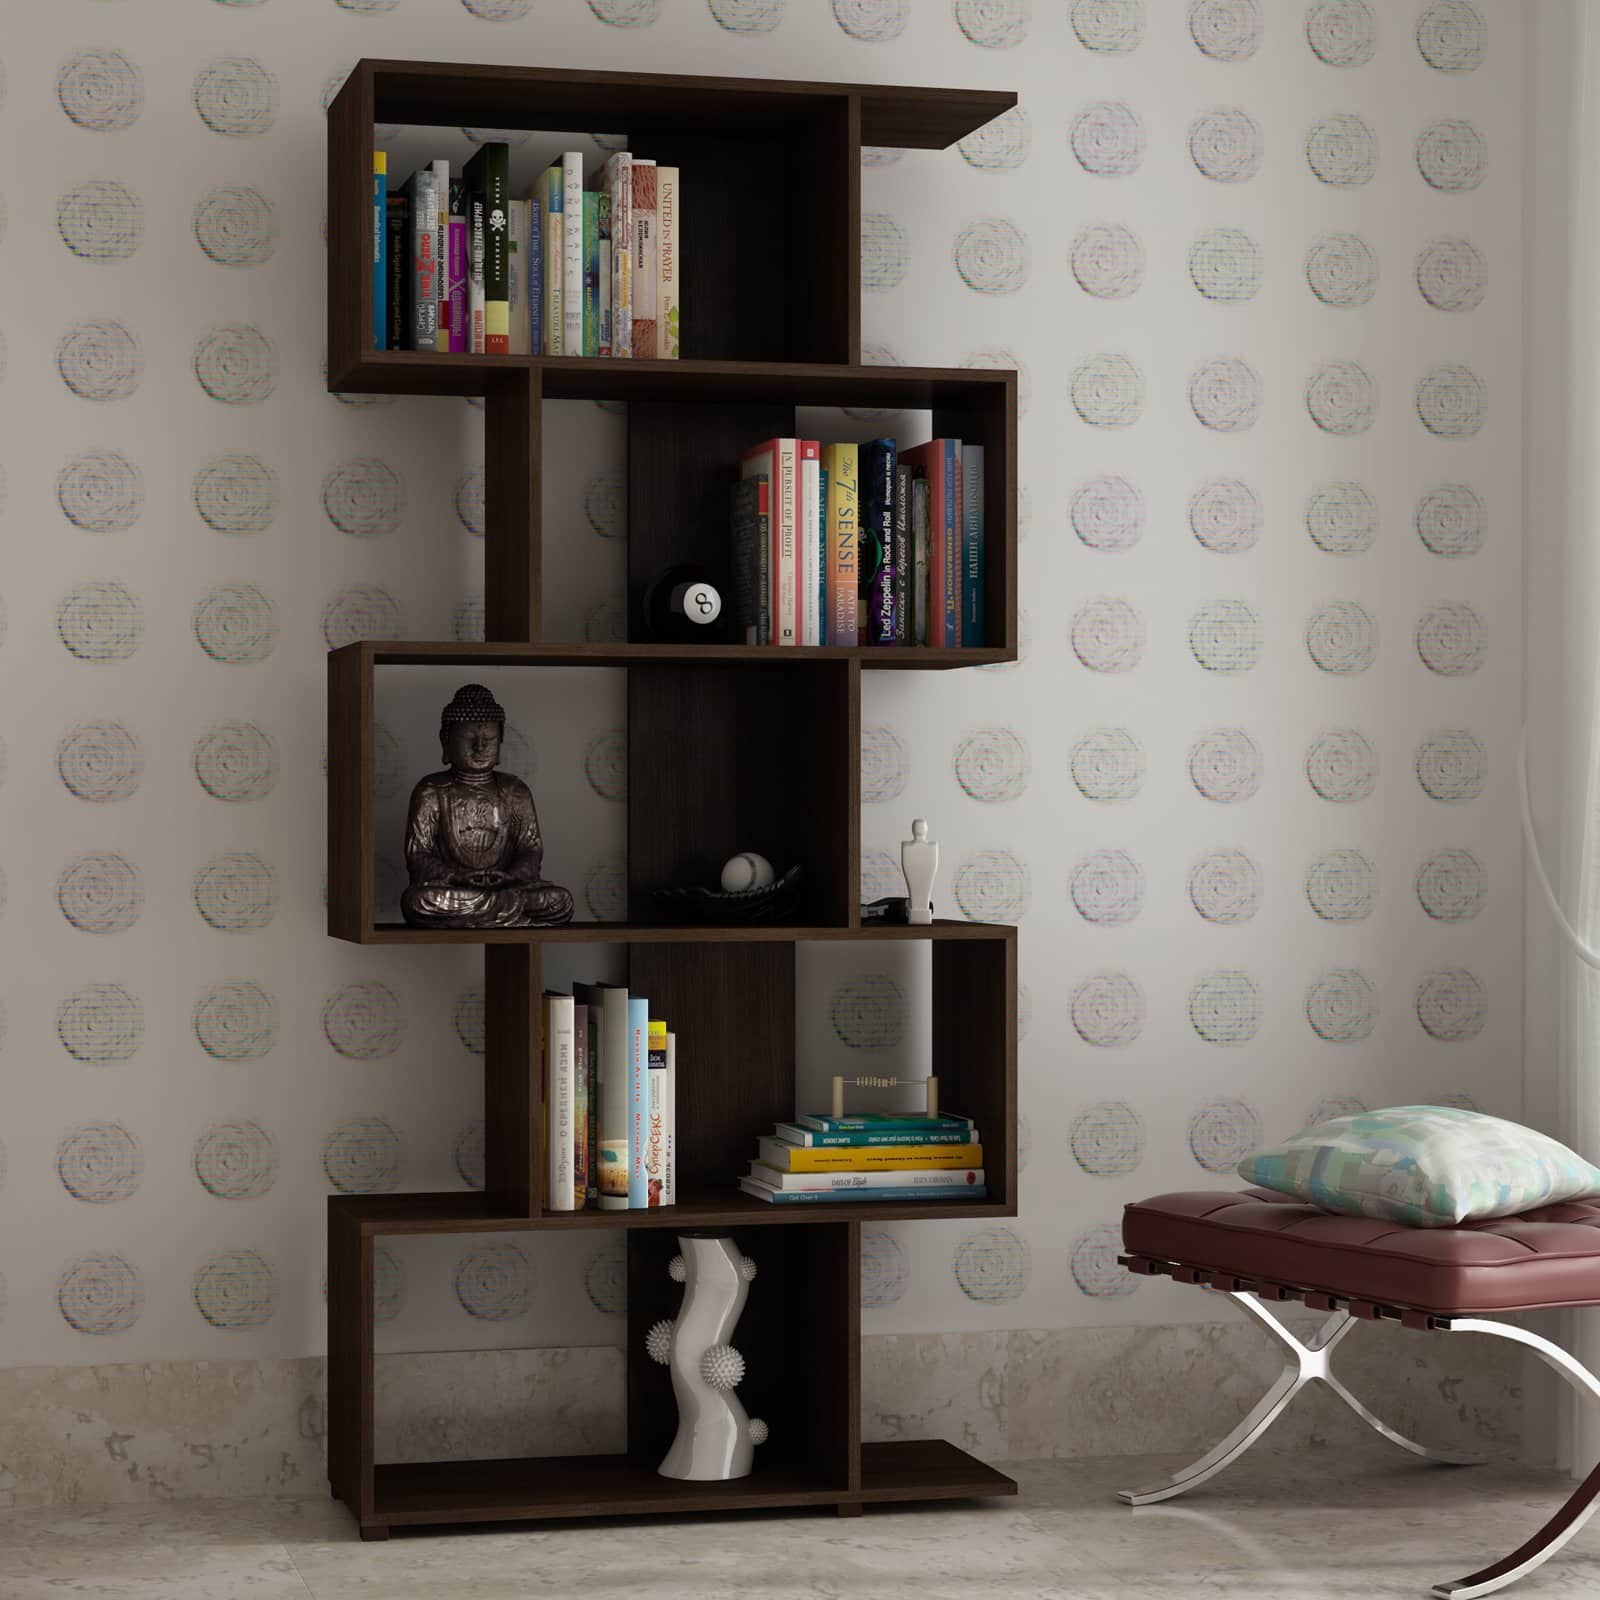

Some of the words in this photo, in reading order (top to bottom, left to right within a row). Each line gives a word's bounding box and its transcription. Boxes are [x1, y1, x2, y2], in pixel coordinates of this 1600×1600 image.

[662, 183, 673, 227] UNITED
[662, 229, 671, 240] IN
[662, 242, 673, 284] PRAYER
[782, 451, 793, 463] IN
[842, 456, 854, 477] The
[782, 466, 793, 505] PURSUIT
[834, 479, 857, 502] 7th
[784, 509, 793, 520] OF
[882, 511, 892, 527] Roll
[782, 525, 793, 560] PROFIT
[837, 507, 855, 574] SENSE
[882, 528, 892, 543] and
[882, 544, 892, 565] Rock
[896, 535, 908, 576] берегов
[882, 565, 891, 573] in
[899, 578, 906, 587] с
[695, 592, 713, 615] 8
[847, 589, 856, 615] PATH
[881, 574, 894, 617] Zeppelin
[836, 587, 846, 634] PARADISE
[895, 591, 906, 640] Записки
[847, 618, 856, 632] TO
[881, 618, 892, 638] Led
[559, 1043, 568, 1073] АЗИИ
[556, 1077, 568, 1127] СРЕДНЕЙ
[648, 1112, 662, 1175] СуперСЕКС
